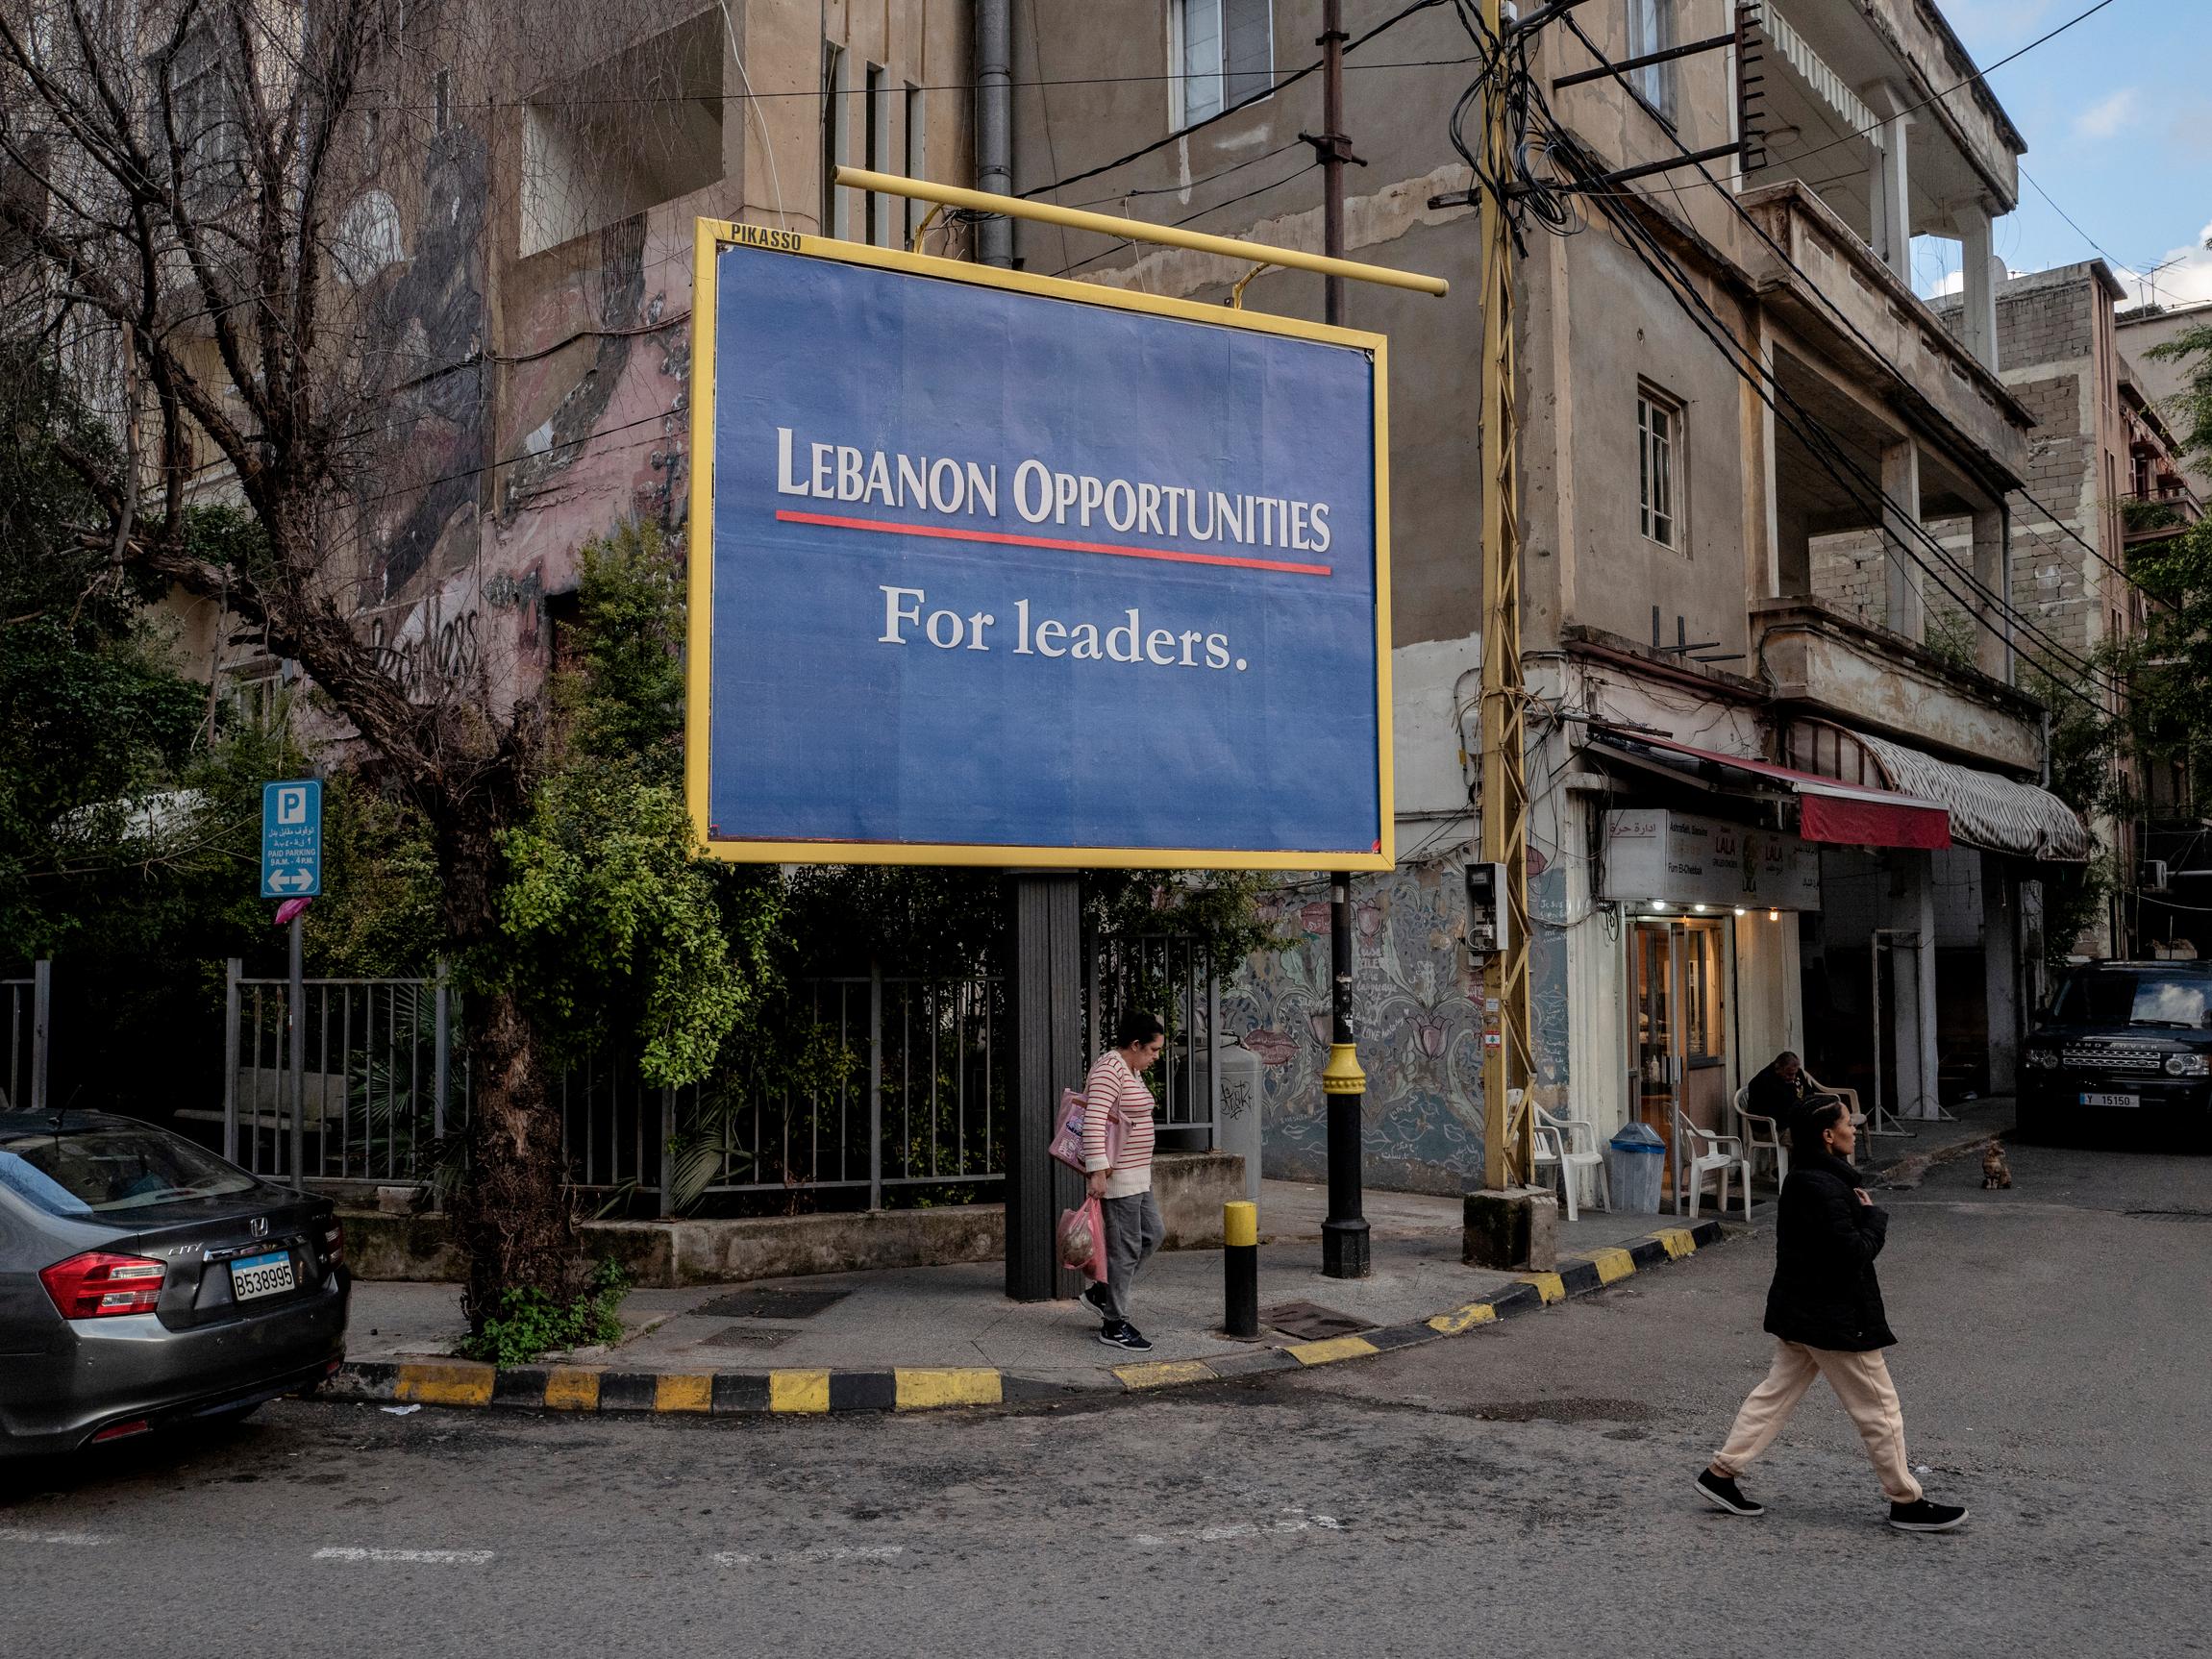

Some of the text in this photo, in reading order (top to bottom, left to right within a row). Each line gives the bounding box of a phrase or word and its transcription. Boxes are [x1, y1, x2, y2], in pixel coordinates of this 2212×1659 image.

[731, 223, 802, 251] PIKASSO
[777, 427, 1331, 554] LEBANON OPPORTUNITIES
[878, 584, 1248, 672] For leaders.
[285, 793, 300, 819] P
[268, 848, 315, 858] PAID PARKING
[1715, 837, 1736, 855] LALA
[1765, 845, 1783, 862] LALA
[2101, 1095, 2131, 1106] 15150
[167, 1242, 205, 1257] CITY
[235, 1265, 294, 1298] B538995
